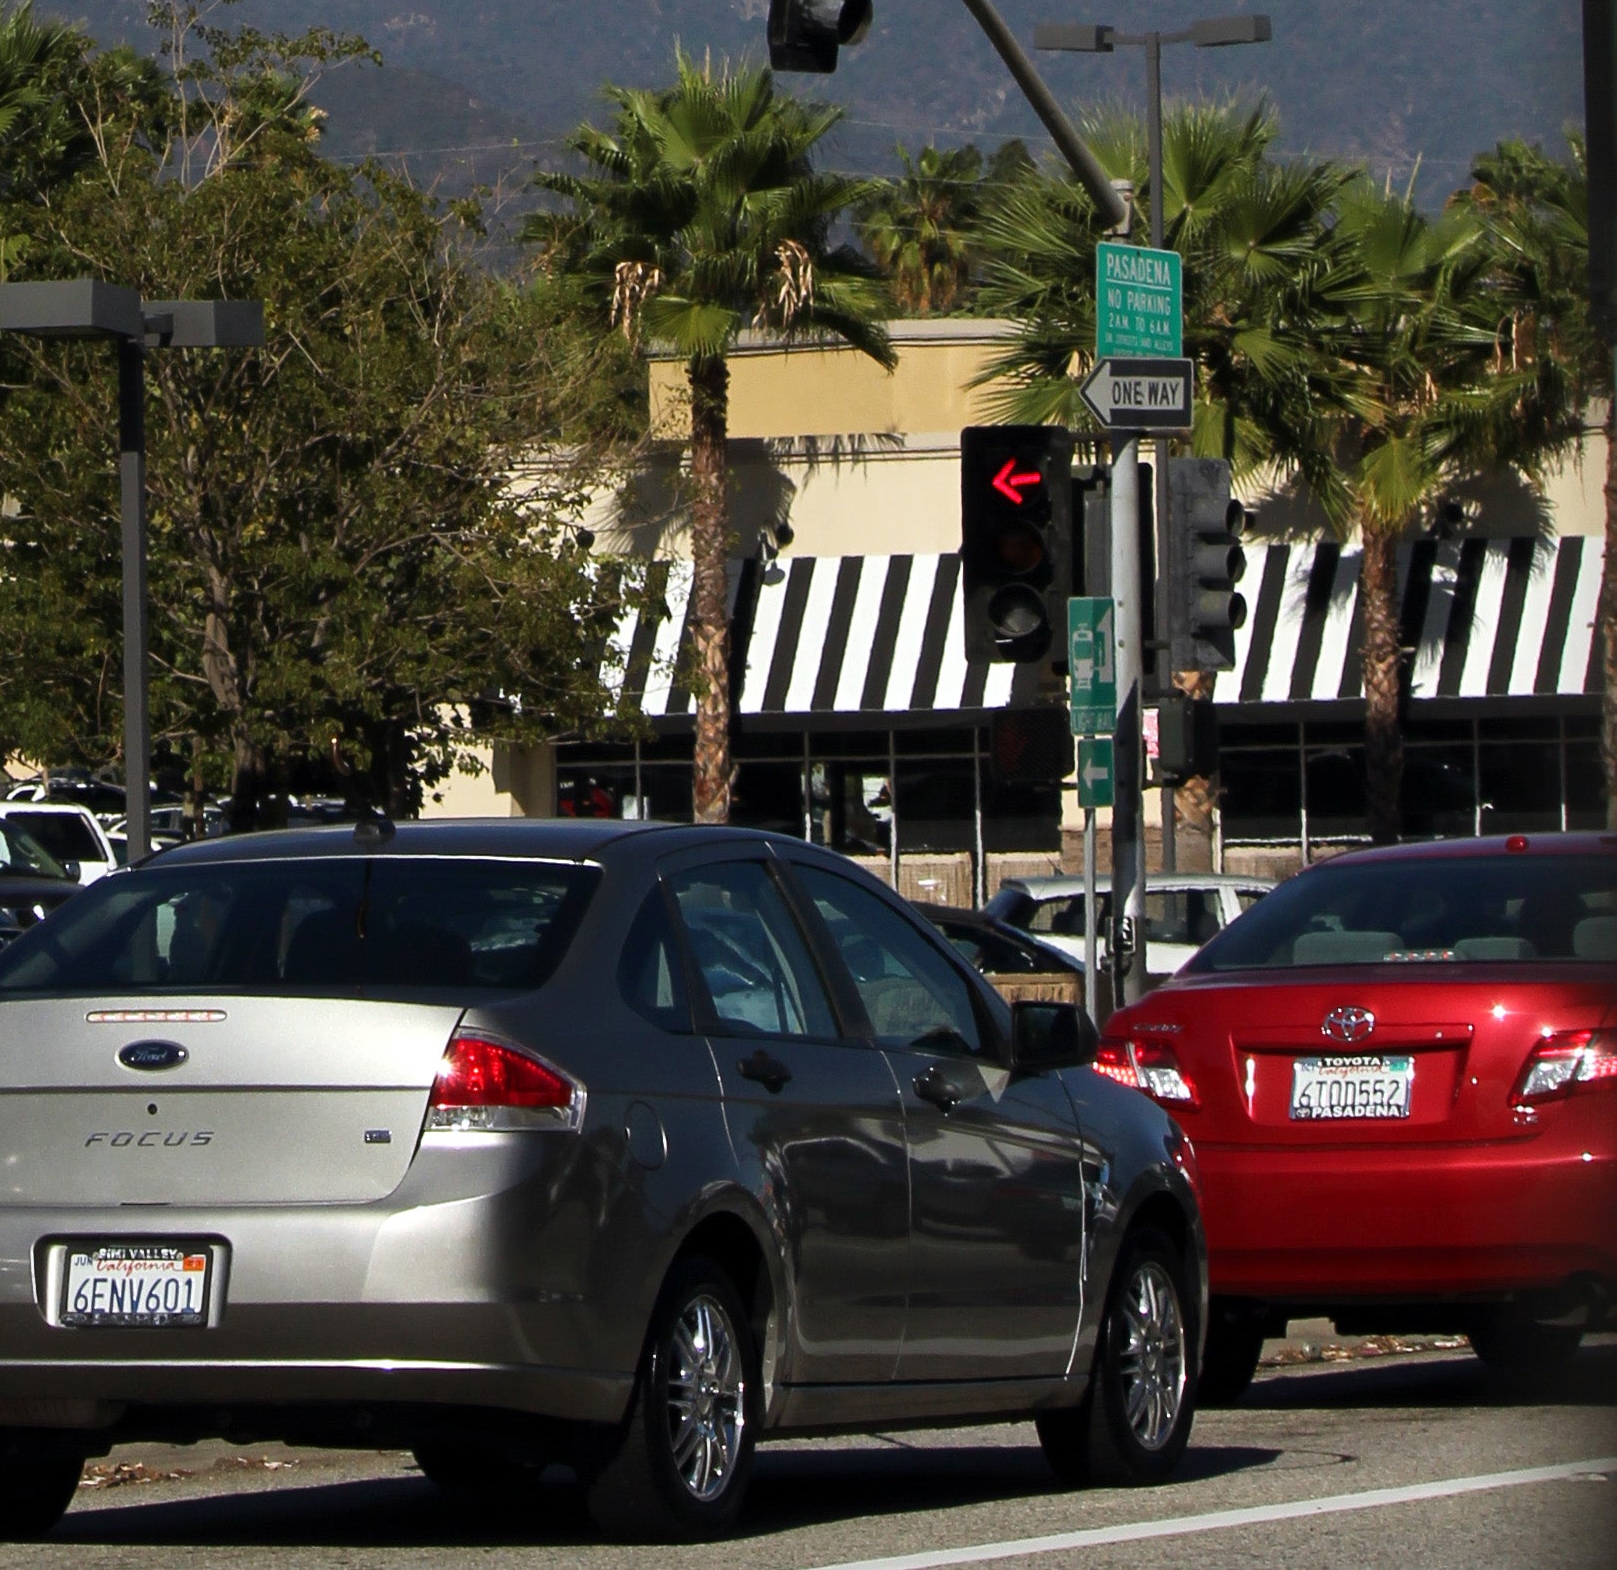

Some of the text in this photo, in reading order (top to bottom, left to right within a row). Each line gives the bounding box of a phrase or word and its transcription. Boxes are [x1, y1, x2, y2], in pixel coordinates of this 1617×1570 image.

[1107, 253, 1171, 286] PASADENA
[1108, 288, 1171, 316] NO PARKING
[1112, 381, 1179, 406] ONE WAY
[1324, 1057, 1381, 1066] TOYOTA
[1311, 1105, 1401, 1118] PASADENA
[84, 1131, 214, 1148] FOCUS
[99, 1248, 178, 1259] SIMI VALLEY
[97, 1259, 176, 1277] California
[74, 1278, 195, 1313] 6ENV601
